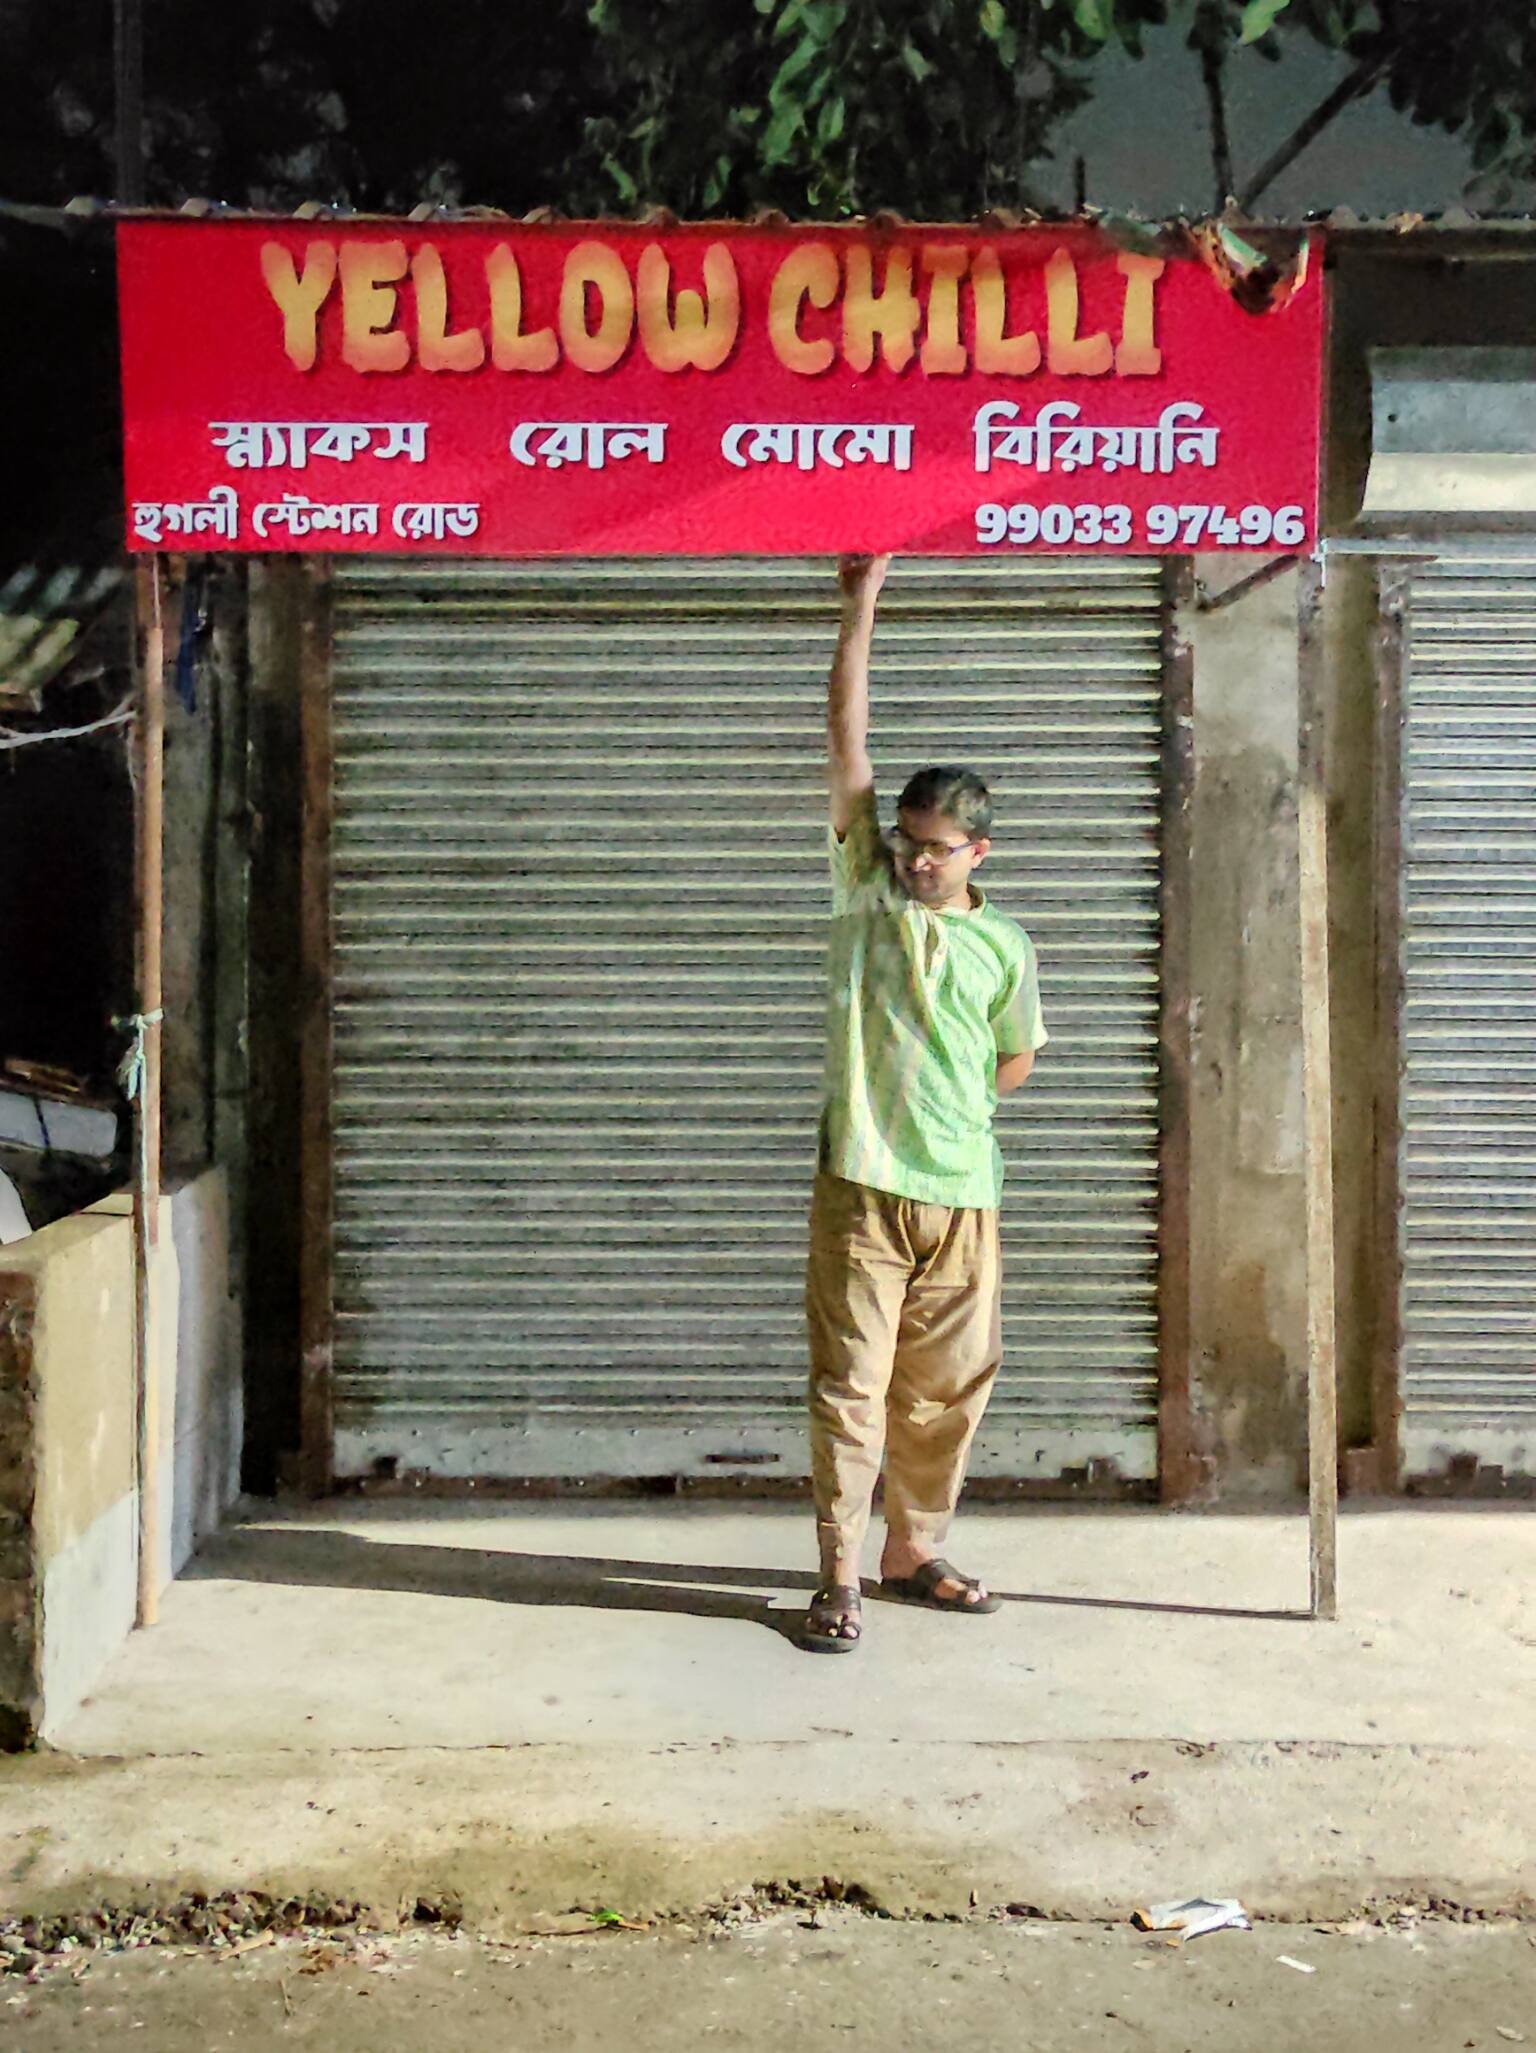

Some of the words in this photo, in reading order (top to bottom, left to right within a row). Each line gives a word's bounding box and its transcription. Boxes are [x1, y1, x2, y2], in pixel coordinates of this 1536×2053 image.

[260, 239, 740, 374] YELLOW
[768, 241, 1166, 376] CHILLI
[509, 421, 669, 470] রোল
[720, 422, 916, 471] মোমো
[972, 400, 1221, 473] বিরিয়ানি
[131, 485, 240, 543] হুগলী
[252, 492, 380, 538] স্টেশন
[391, 502, 481, 540] রোড
[974, 503, 1133, 545] 99033
[1145, 504, 1306, 546] 97496
